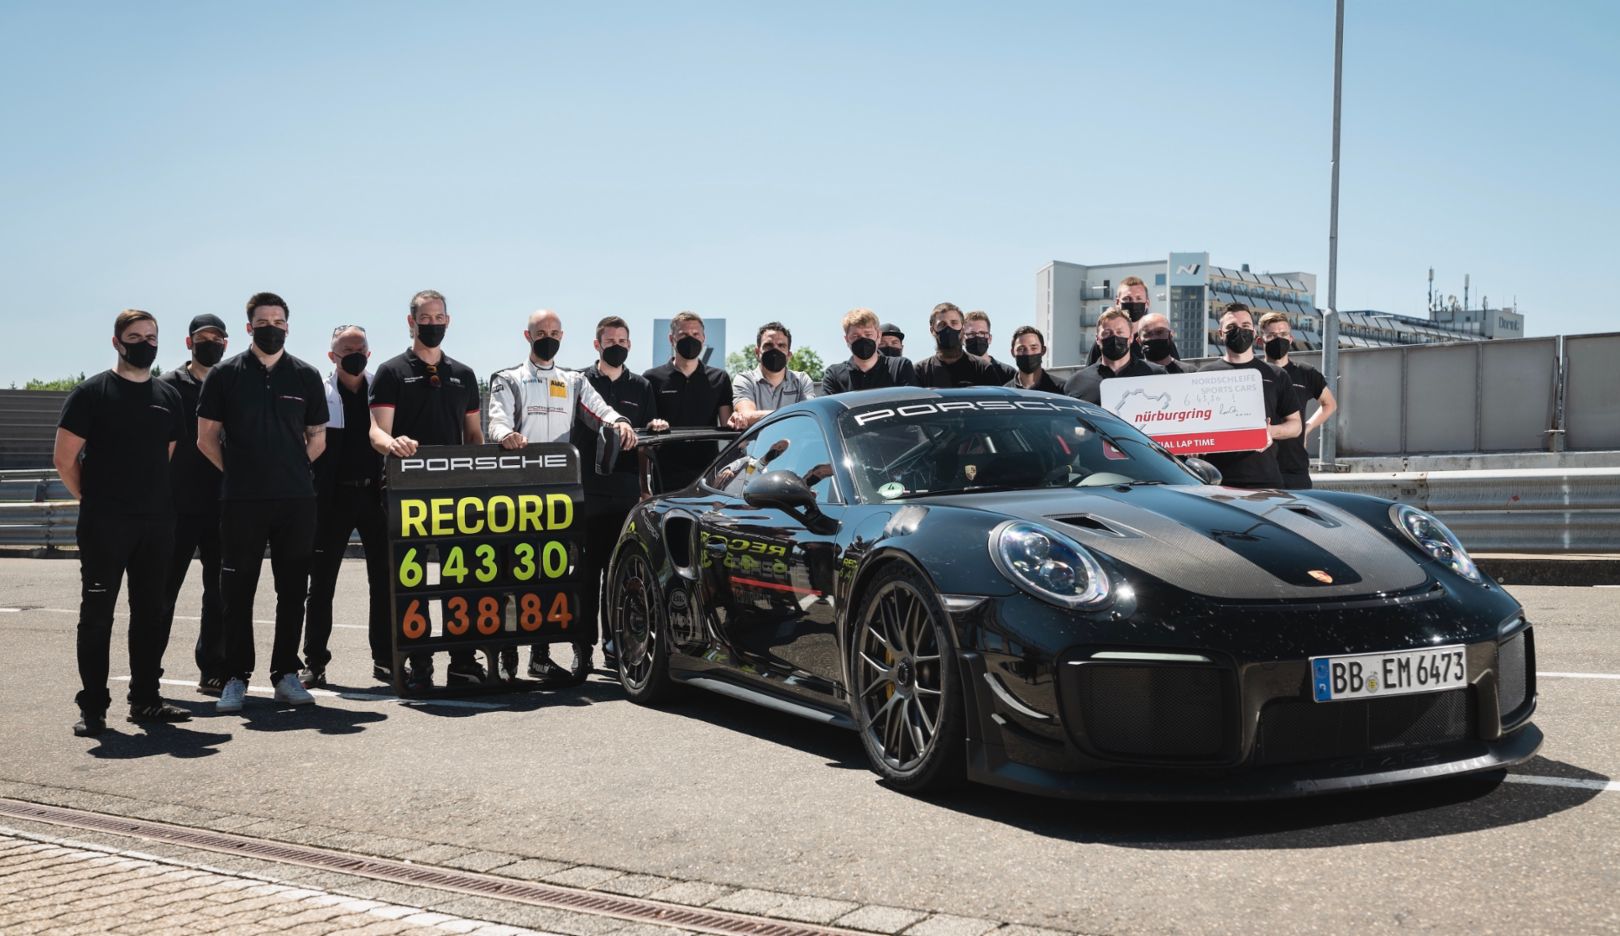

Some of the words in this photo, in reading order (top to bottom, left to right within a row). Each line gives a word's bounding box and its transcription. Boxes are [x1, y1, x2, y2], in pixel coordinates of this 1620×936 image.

[1191, 374, 1257, 386] NORDSCHLEIFE
[1200, 385, 1234, 394] SPORTS
[1234, 383, 1257, 392] CARS
[853, 400, 1105, 427] PORSCHE
[1134, 407, 1213, 423] nürburgring
[1176, 439, 1193, 449] LAP
[1193, 438, 1216, 447] TIME
[400, 454, 568, 473] PORSCHE
[400, 493, 575, 538] RECORD
[399, 547, 424, 588] 6
[402, 599, 427, 639] 6
[1332, 661, 1364, 694] BB
[1382, 657, 1412, 689] EM
[1416, 651, 1465, 685] 6473
